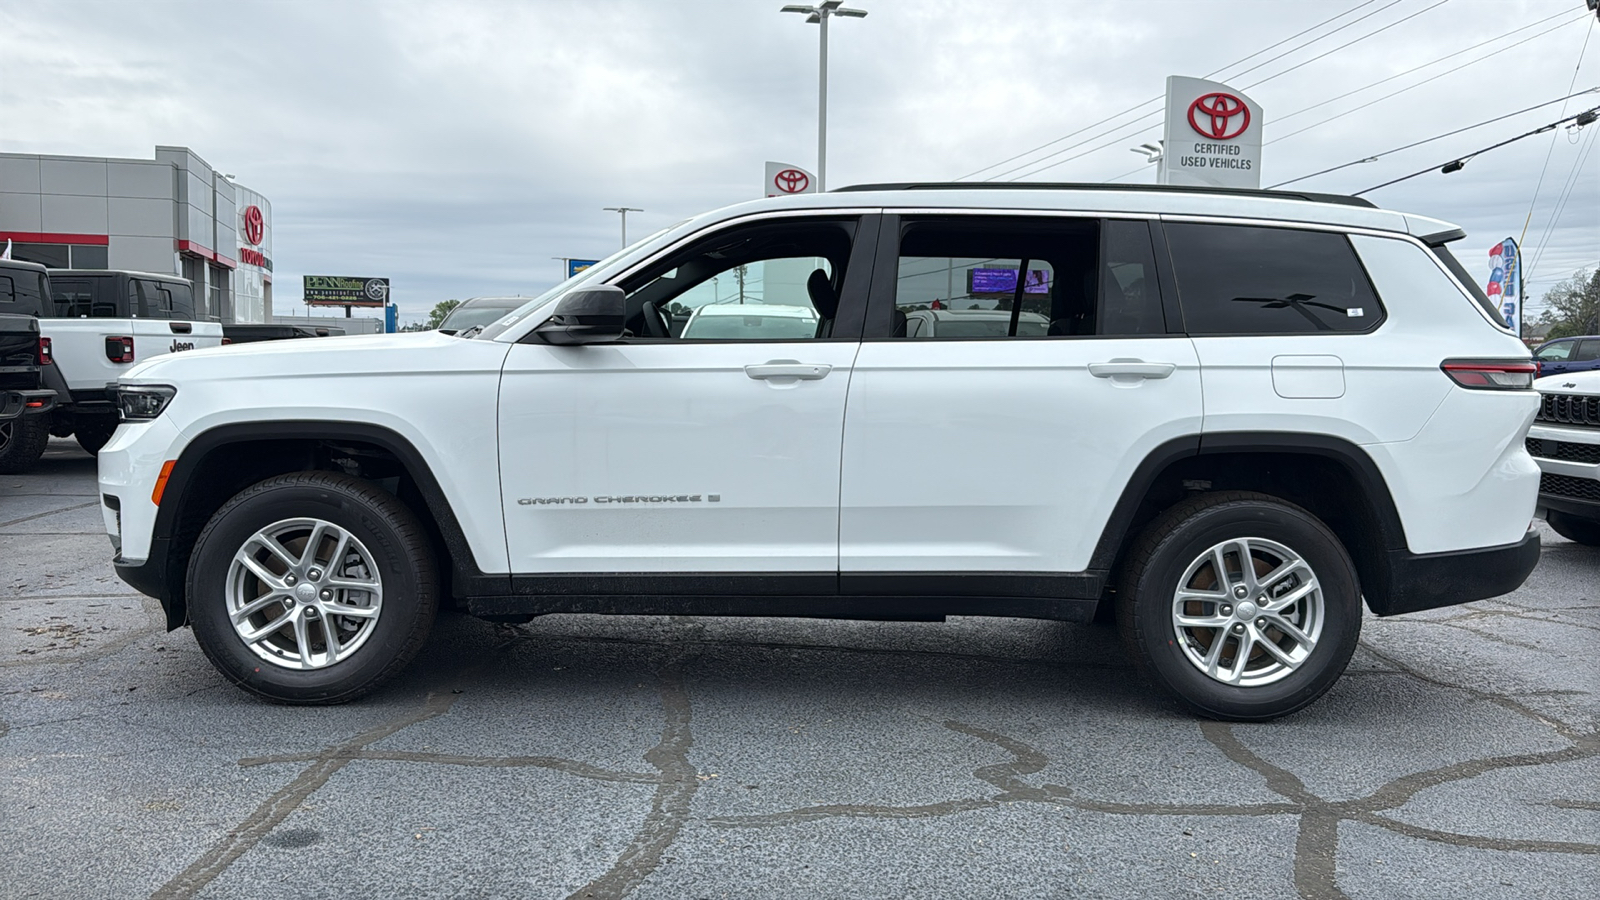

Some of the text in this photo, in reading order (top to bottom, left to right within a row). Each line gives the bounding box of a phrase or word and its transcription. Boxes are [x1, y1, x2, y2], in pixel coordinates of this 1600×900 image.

[1194, 143, 1240, 155] CERTIFIED
[1181, 156, 1251, 170] USED VEHICLES
[306, 276, 341, 288] PENN
[340, 279, 364, 290] Roofing
[517, 497, 588, 505] GRAND
[593, 494, 702, 503] CHEROKEE
